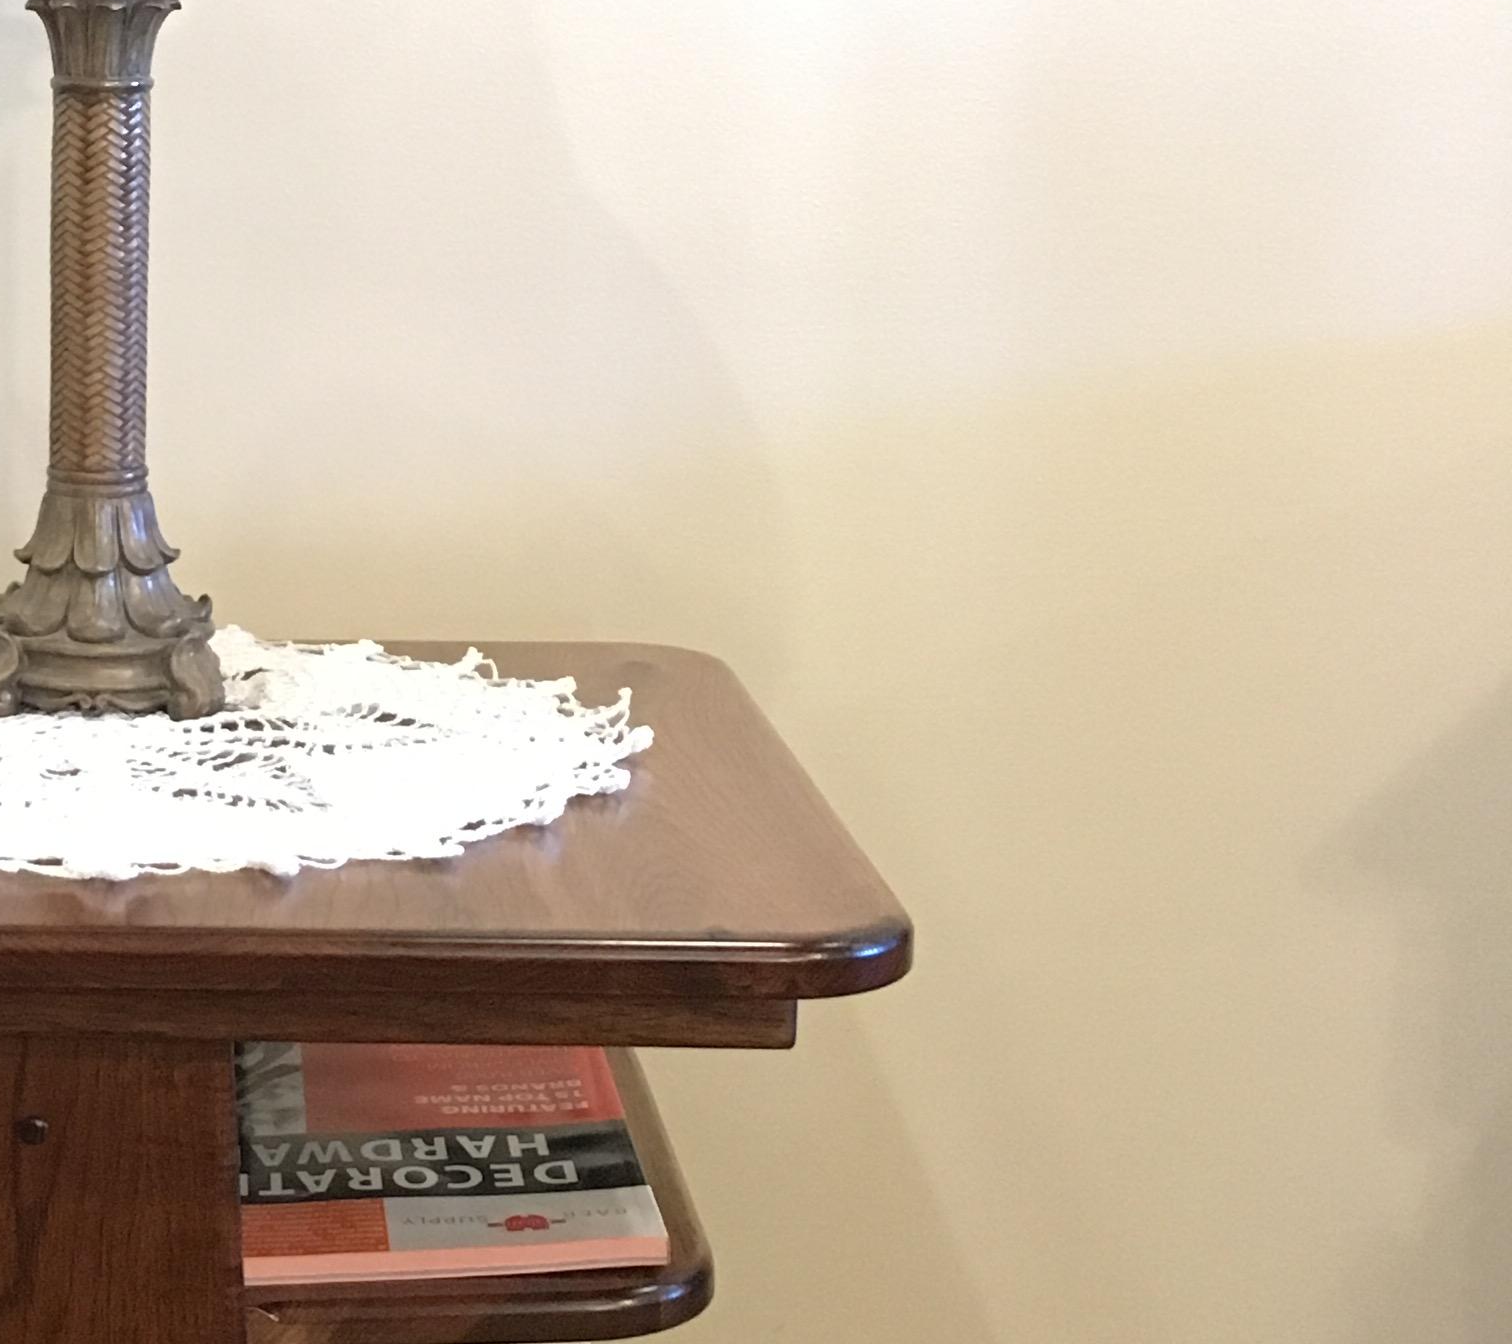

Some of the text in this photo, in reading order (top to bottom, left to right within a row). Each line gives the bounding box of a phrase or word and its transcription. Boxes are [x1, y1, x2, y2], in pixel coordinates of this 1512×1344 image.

[414, 1094, 491, 1104] NAME
[498, 1091, 551, 1102] TOP
[441, 1099, 590, 1115] FEATURING
[253, 1132, 550, 1168] HARDWA
